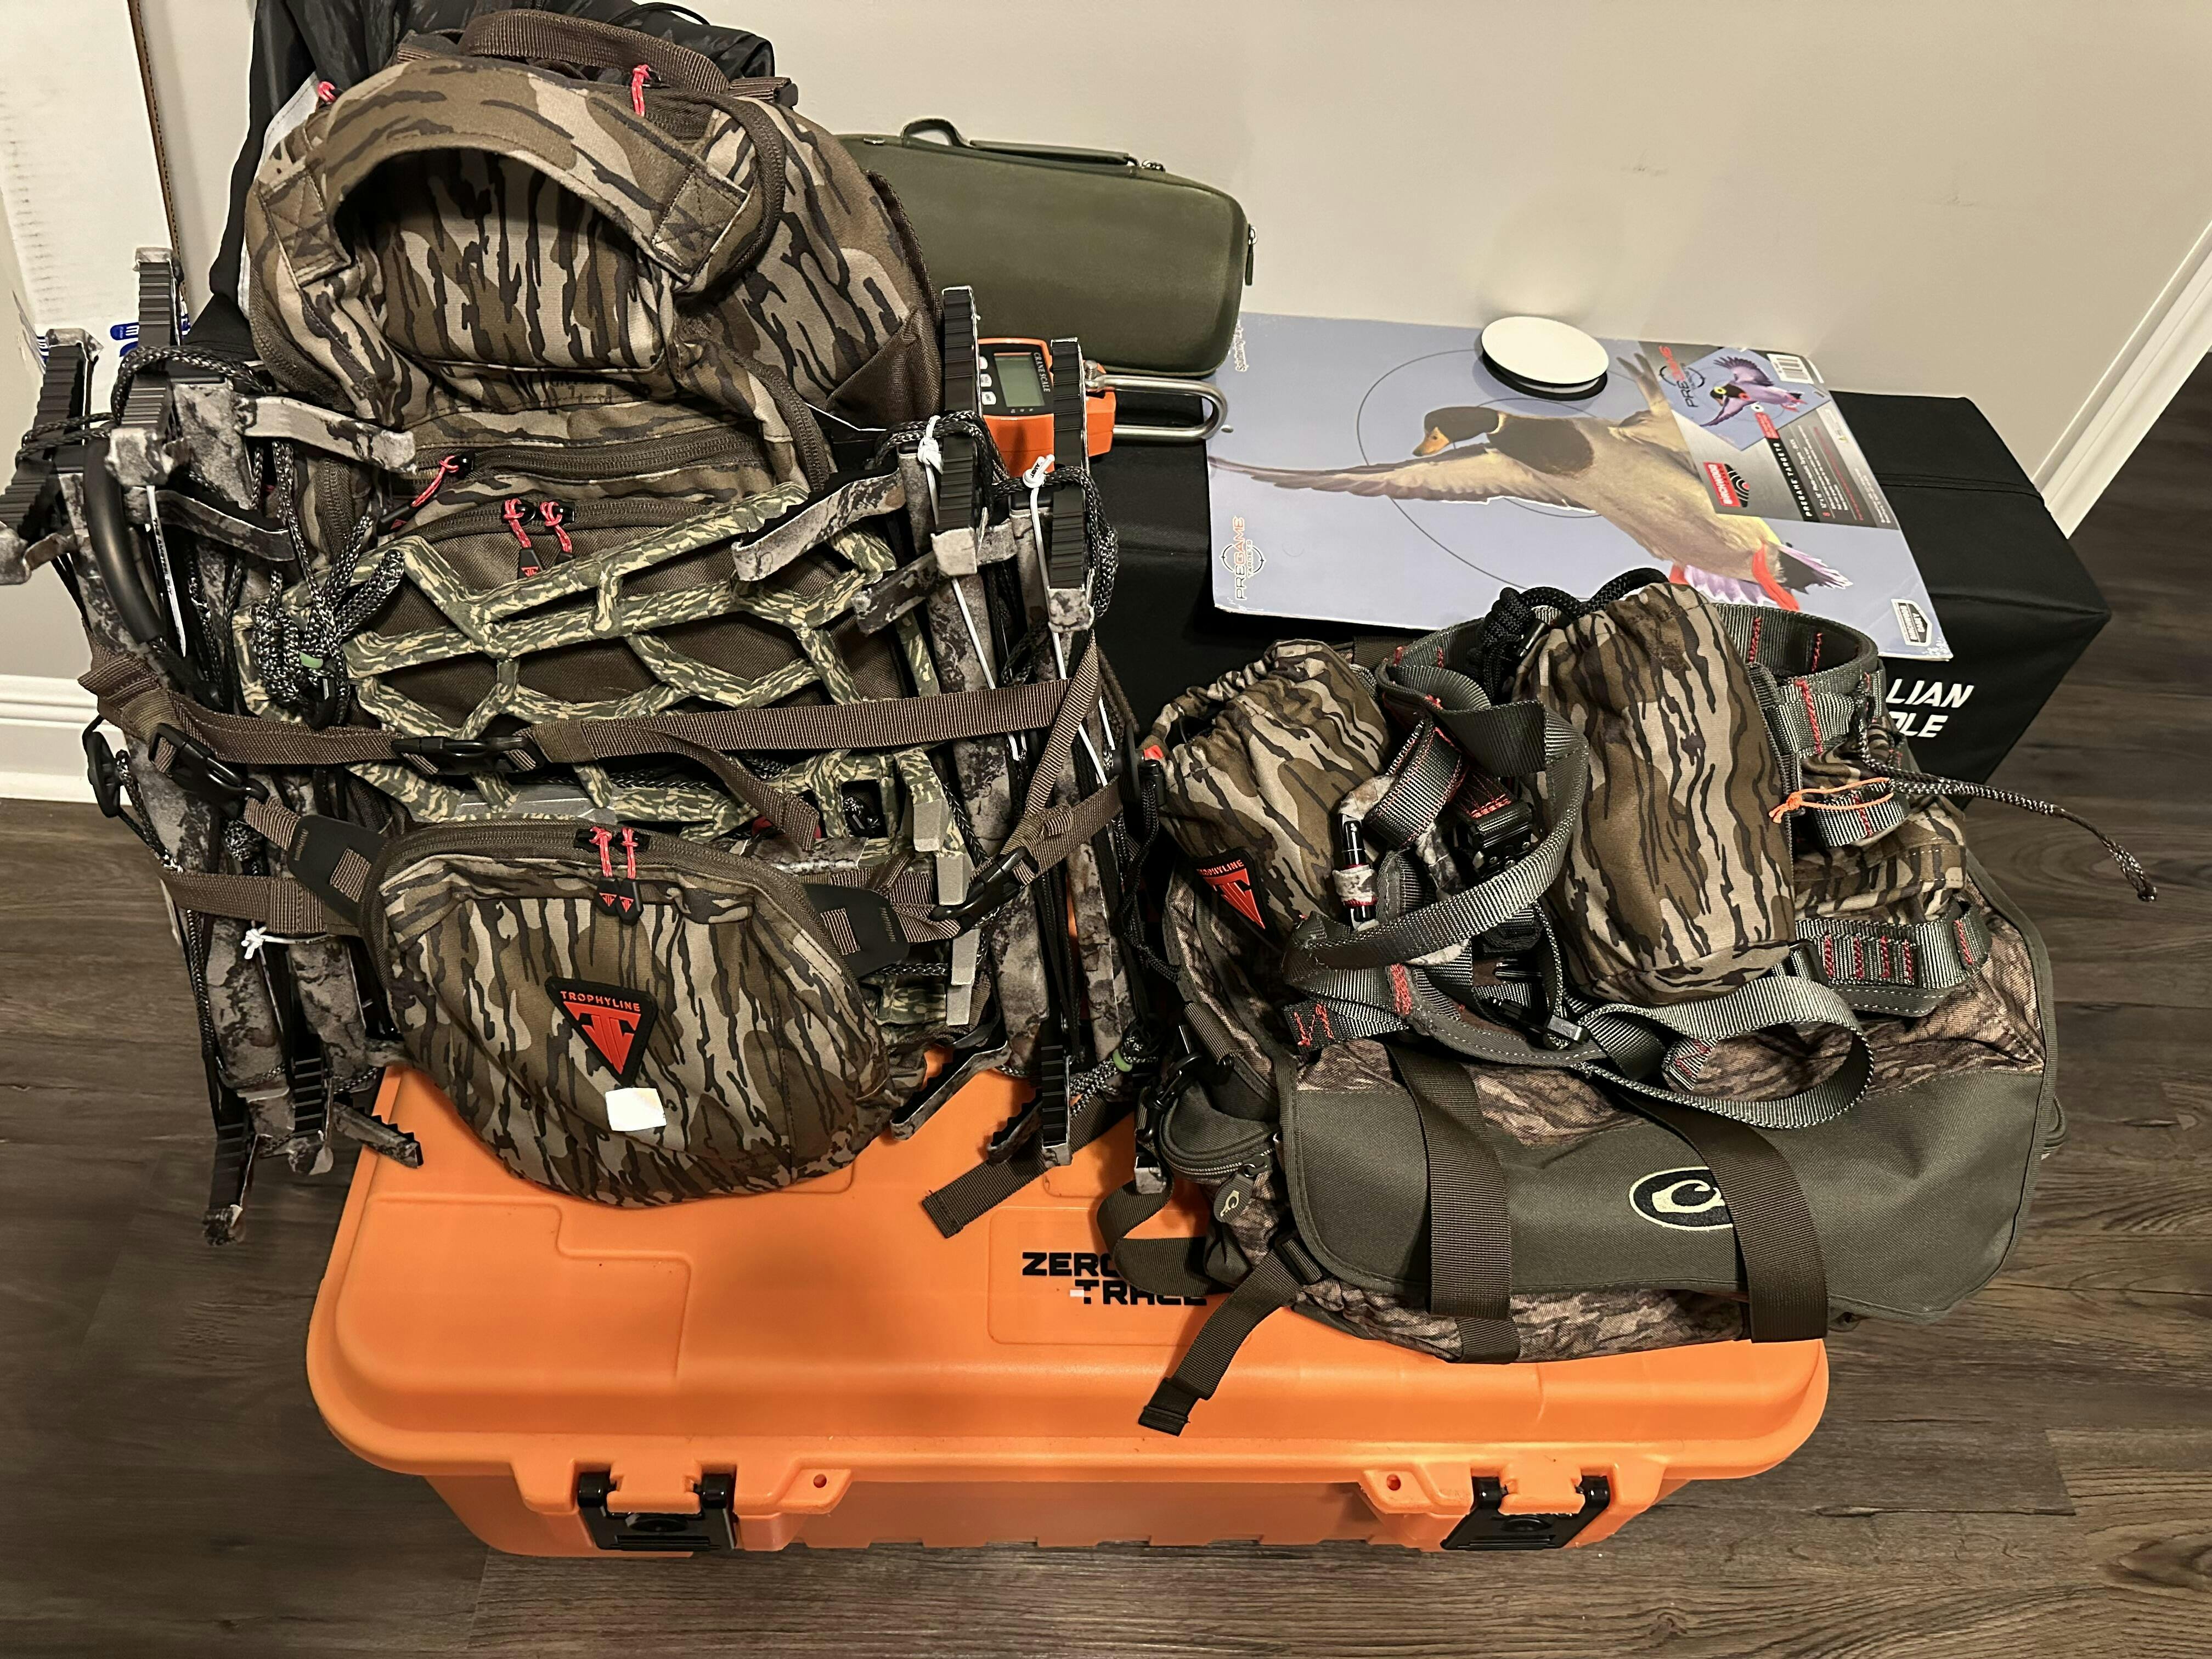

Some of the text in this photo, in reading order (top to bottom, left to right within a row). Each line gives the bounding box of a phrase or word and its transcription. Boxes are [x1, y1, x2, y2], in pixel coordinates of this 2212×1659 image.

[1034, 352, 1051, 392] CRANE SCALE
[1708, 464, 1733, 505] BIRCHWOOD
[1233, 516, 1246, 600] PREGAME
[1900, 605, 1917, 640] BIRCHWOOD
[1912, 613, 1925, 633] CASEY
[560, 990, 641, 1012] TROPHYLINE
